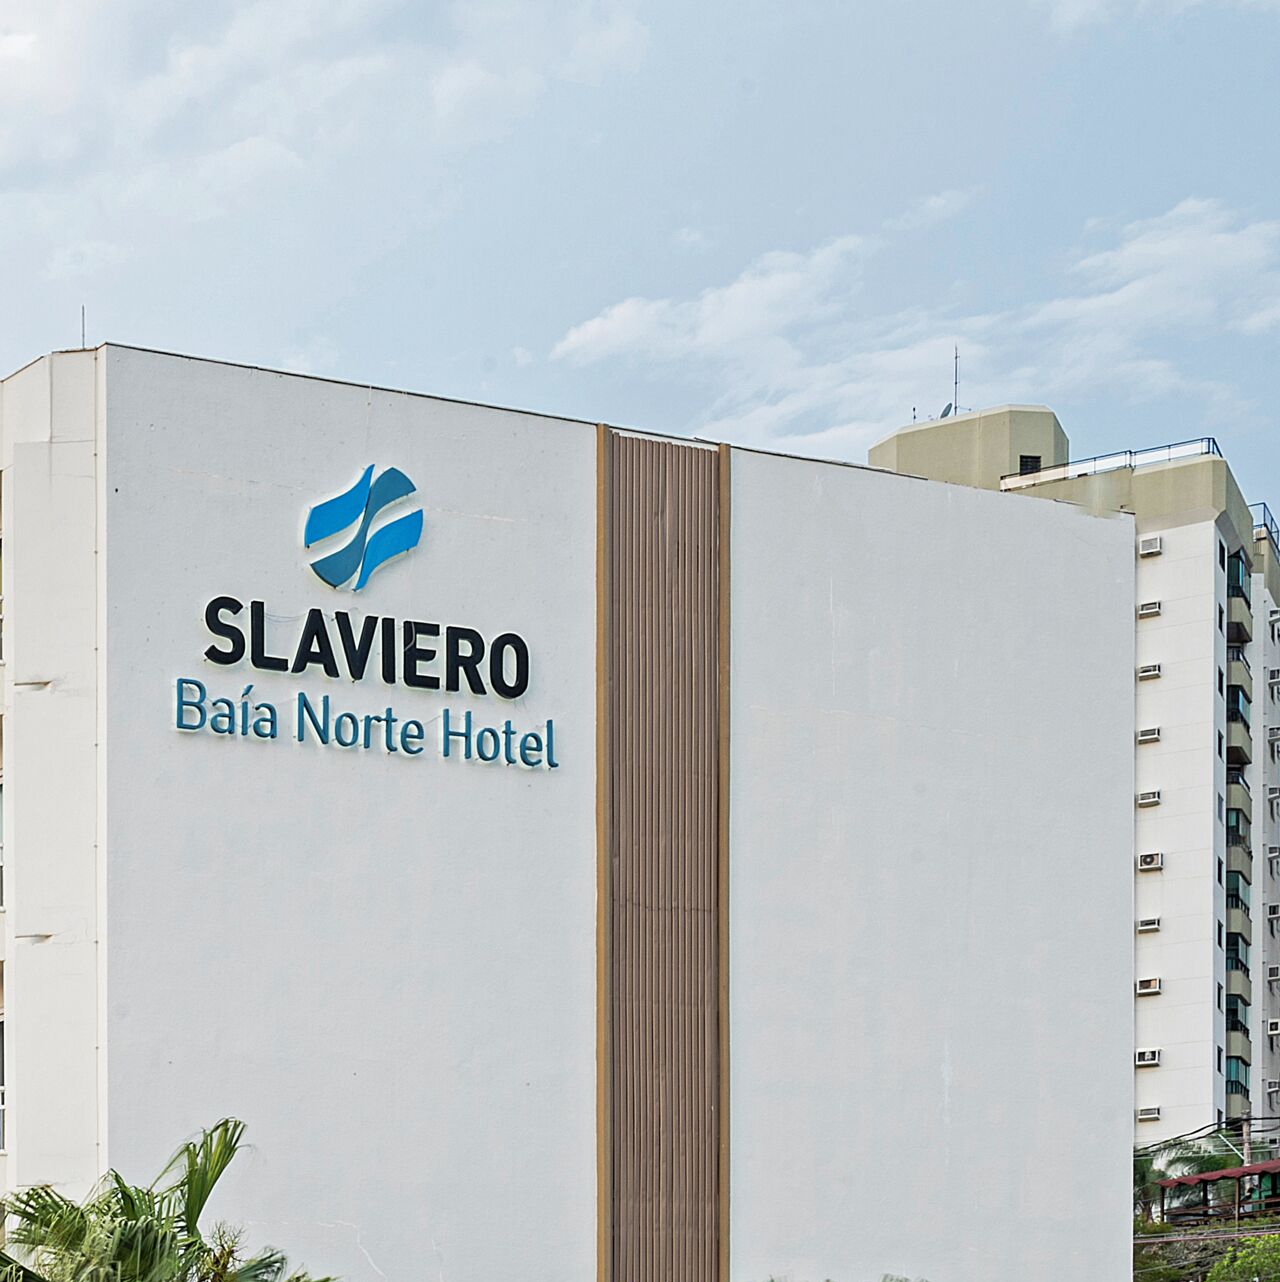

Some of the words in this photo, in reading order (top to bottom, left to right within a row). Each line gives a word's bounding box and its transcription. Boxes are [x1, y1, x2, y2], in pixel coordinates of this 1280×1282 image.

[204, 595, 530, 700] SLAVIERO
[175, 677, 278, 739] Baía
[297, 692, 426, 755] Norte
[442, 708, 560, 769] Hotel
